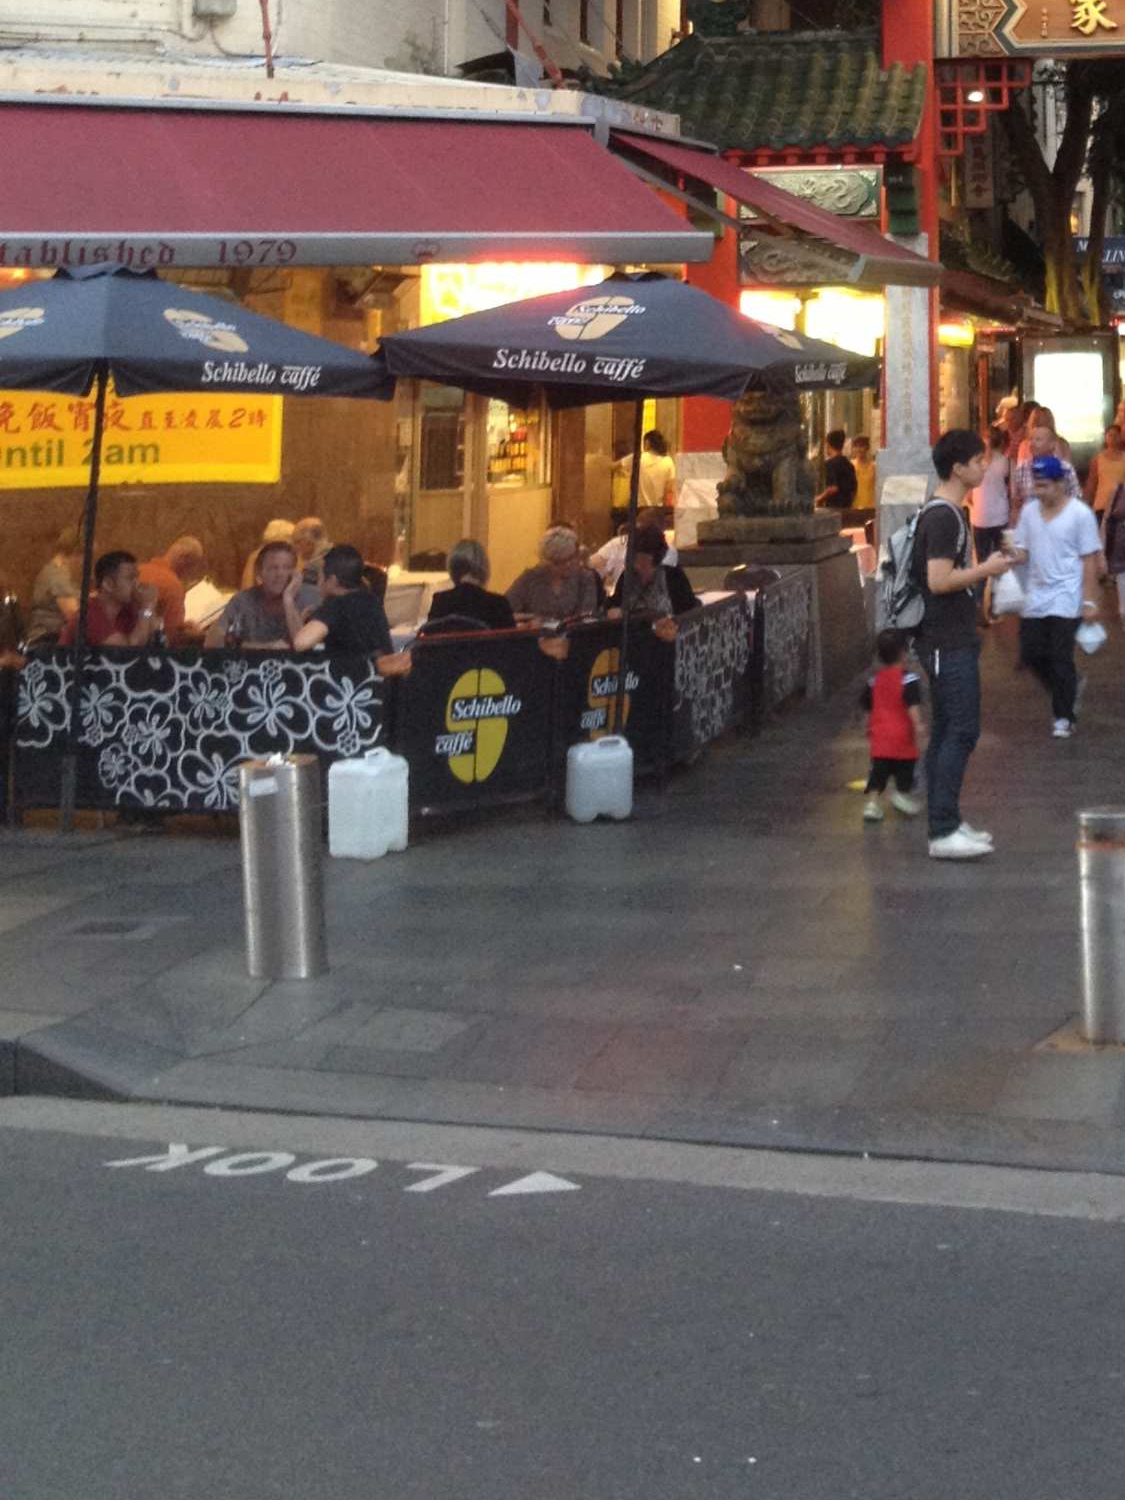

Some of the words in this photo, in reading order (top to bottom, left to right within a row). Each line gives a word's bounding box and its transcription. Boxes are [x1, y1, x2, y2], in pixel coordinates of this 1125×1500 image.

[217, 240, 298, 264] 1979
[202, 361, 276, 384] Schibello
[493, 349, 586, 373] Schibello
[0, 439, 64, 469] ntil
[452, 693, 521, 721] Schibello
[102, 1142, 482, 1193] LOOK
